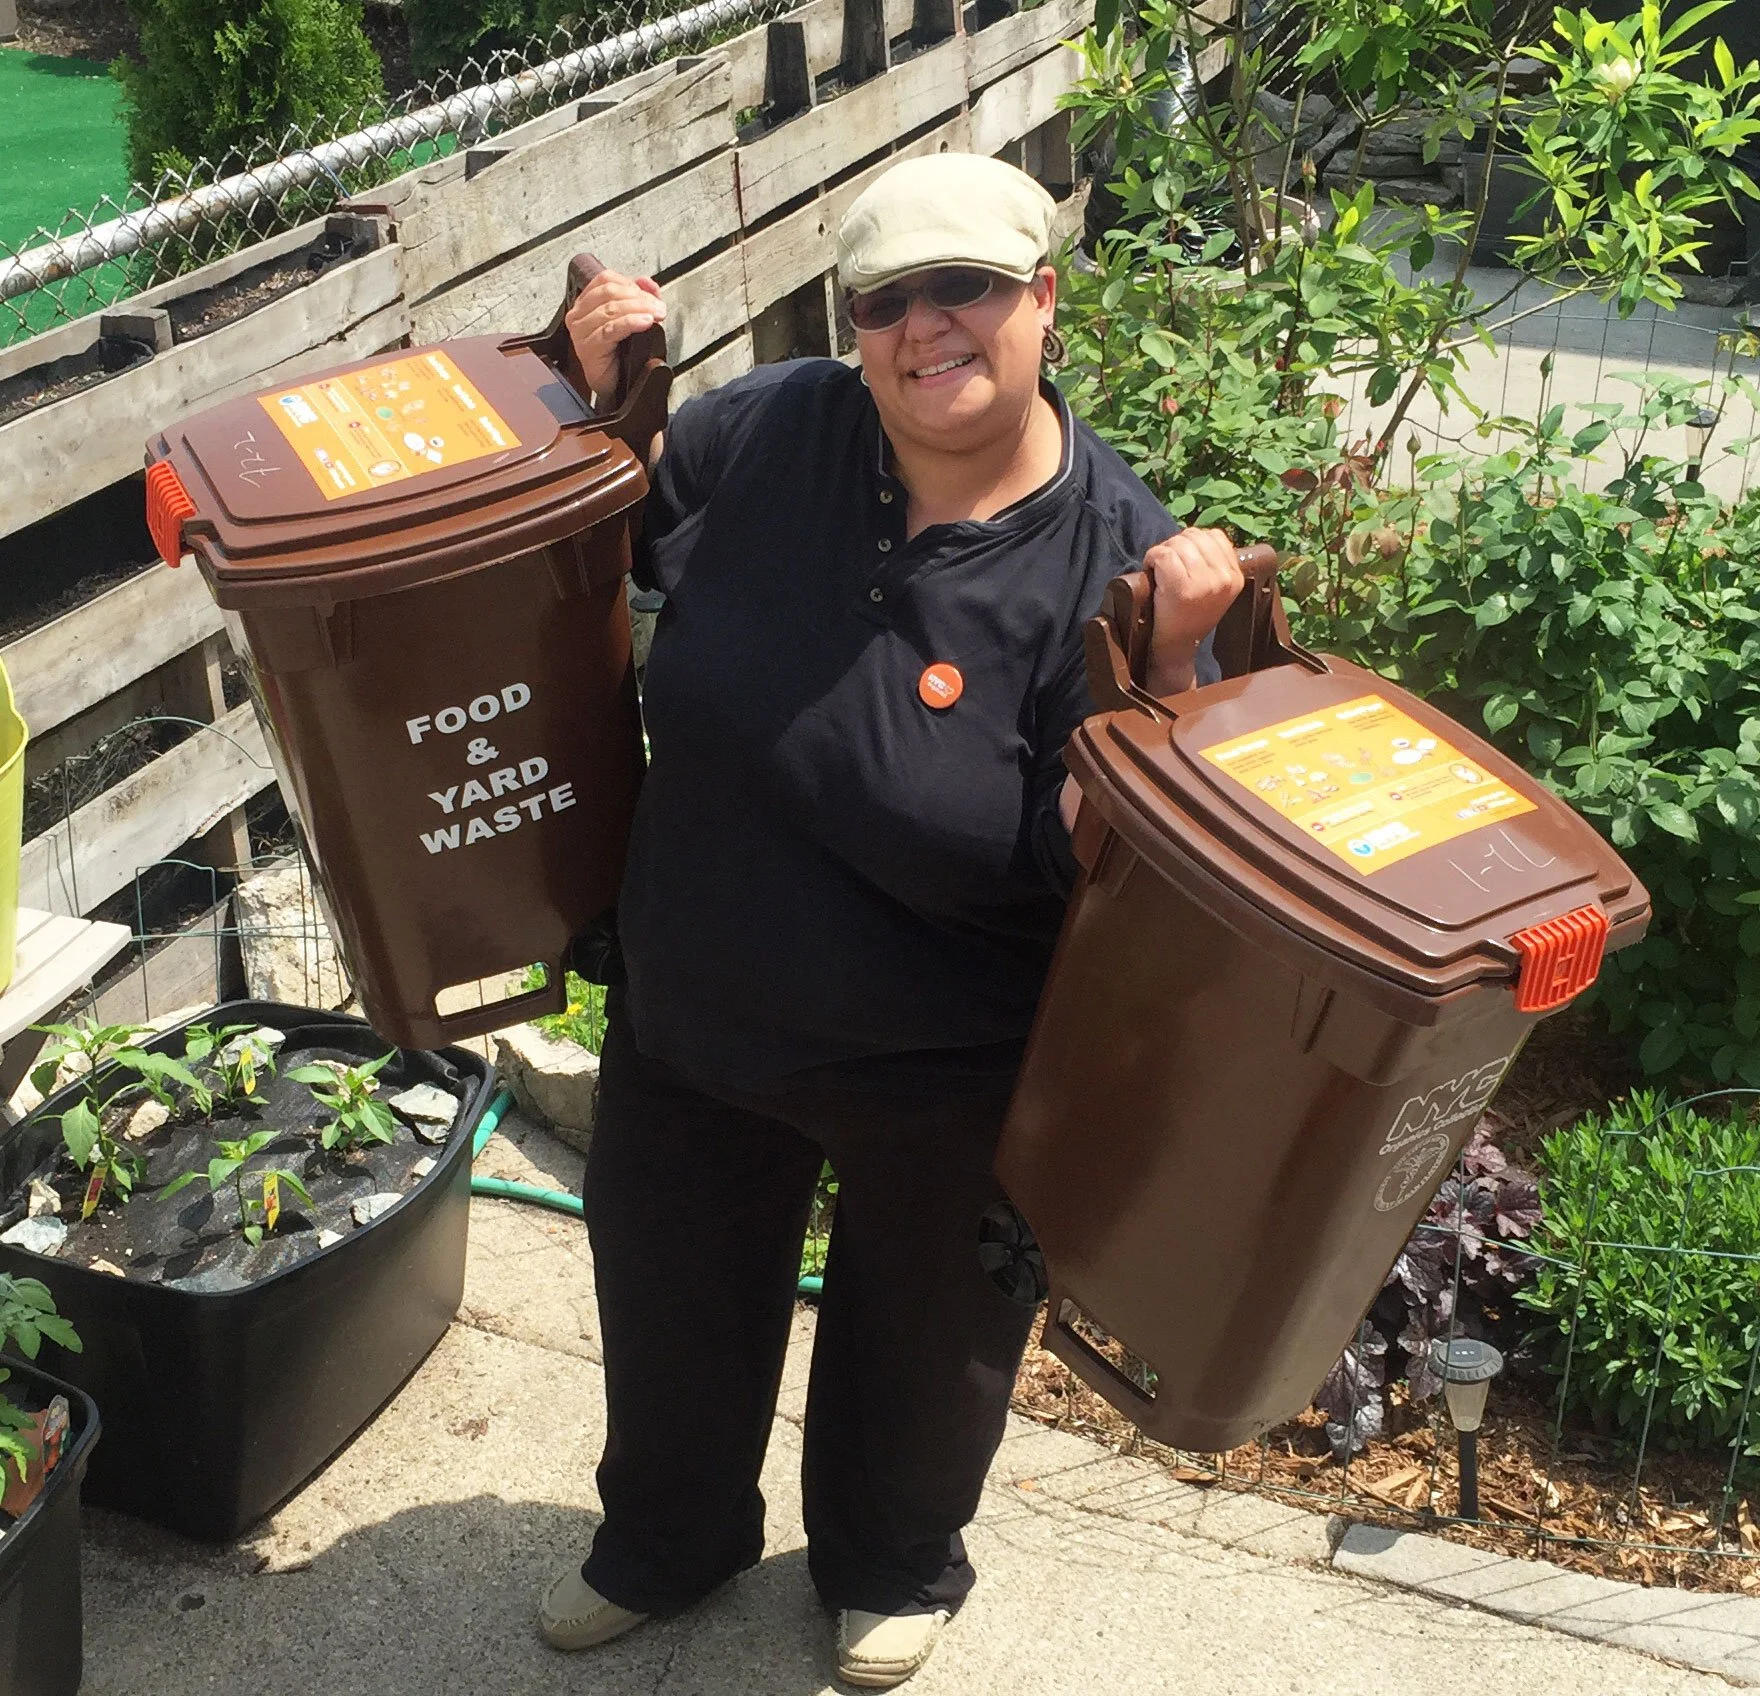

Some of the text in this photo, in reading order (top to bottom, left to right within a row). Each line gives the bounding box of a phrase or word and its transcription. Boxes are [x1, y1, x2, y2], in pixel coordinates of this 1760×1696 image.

[406, 682, 531, 745] FOOD
[466, 737, 500, 766] &
[427, 756, 549, 814] YARD
[419, 782, 577, 854] WASTE
[1386, 1056, 1509, 1142] NYC
